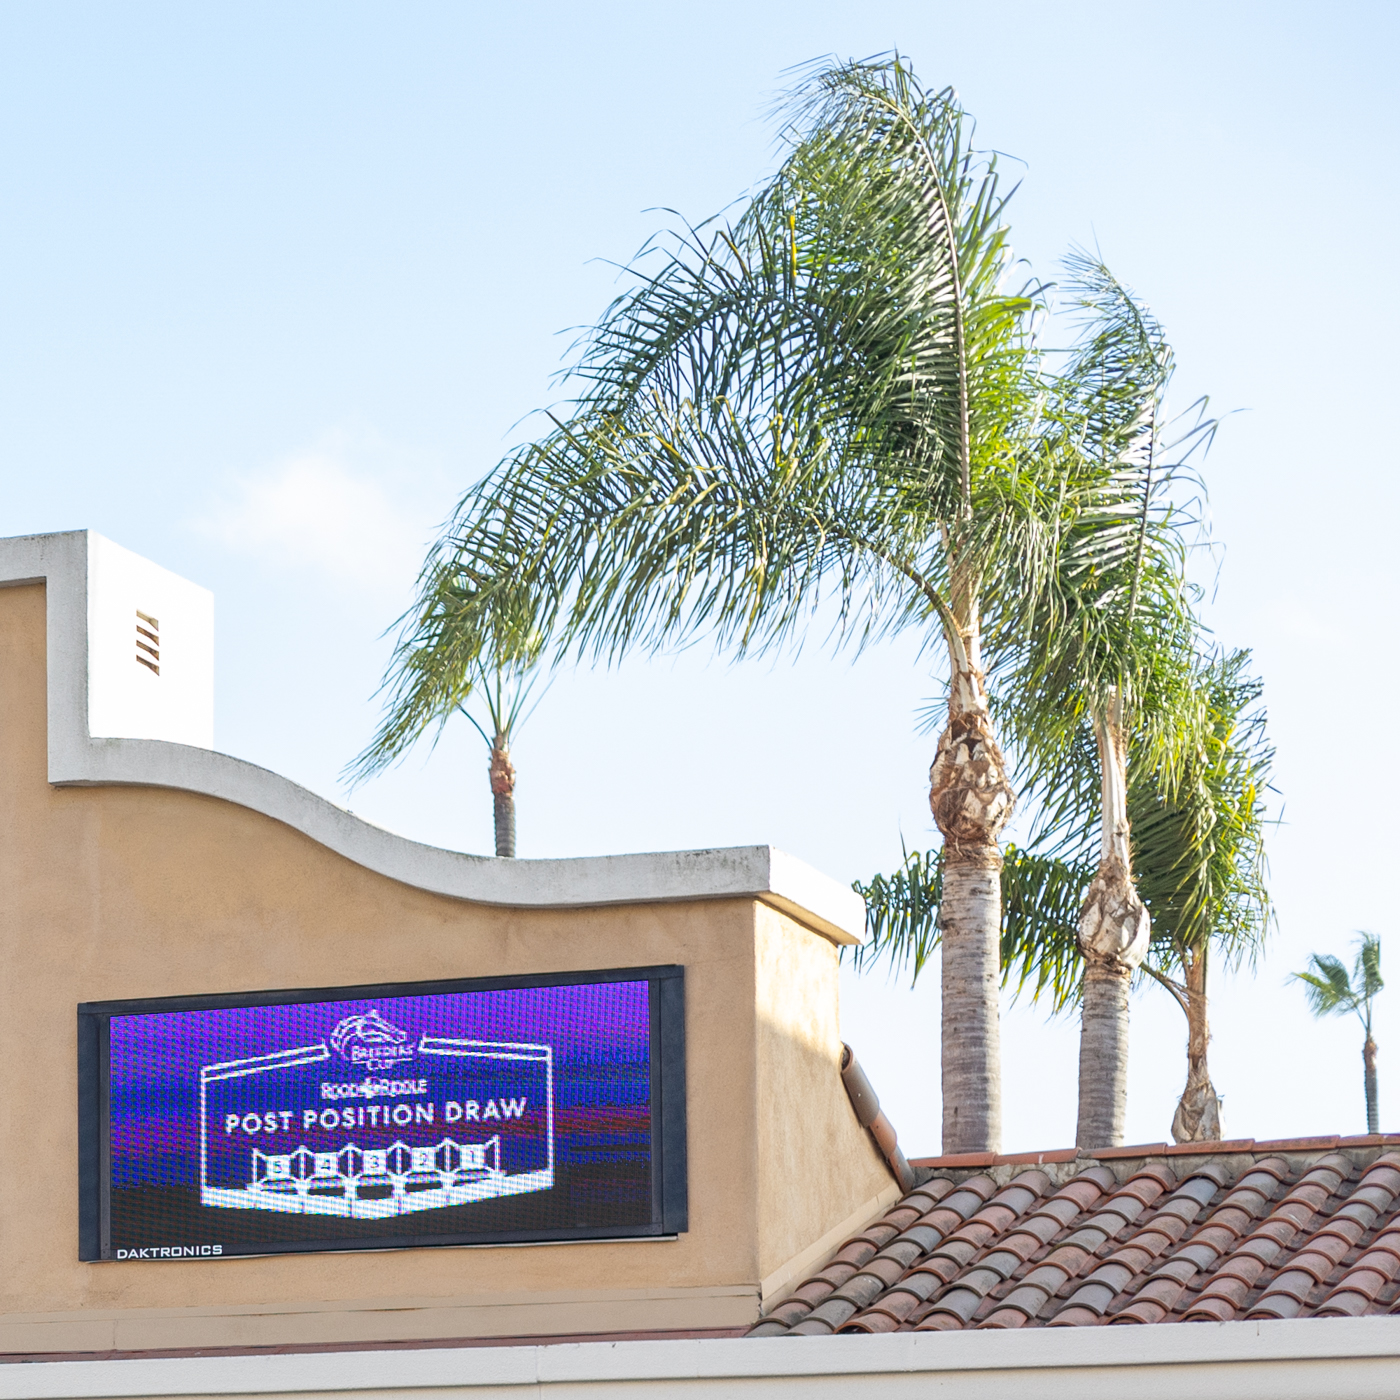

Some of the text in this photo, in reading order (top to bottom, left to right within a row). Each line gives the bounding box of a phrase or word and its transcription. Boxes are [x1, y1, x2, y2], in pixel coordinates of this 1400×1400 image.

[225, 1097, 526, 1134] POST POSITION DRAW
[117, 1245, 223, 1259] DAKTRONICS
